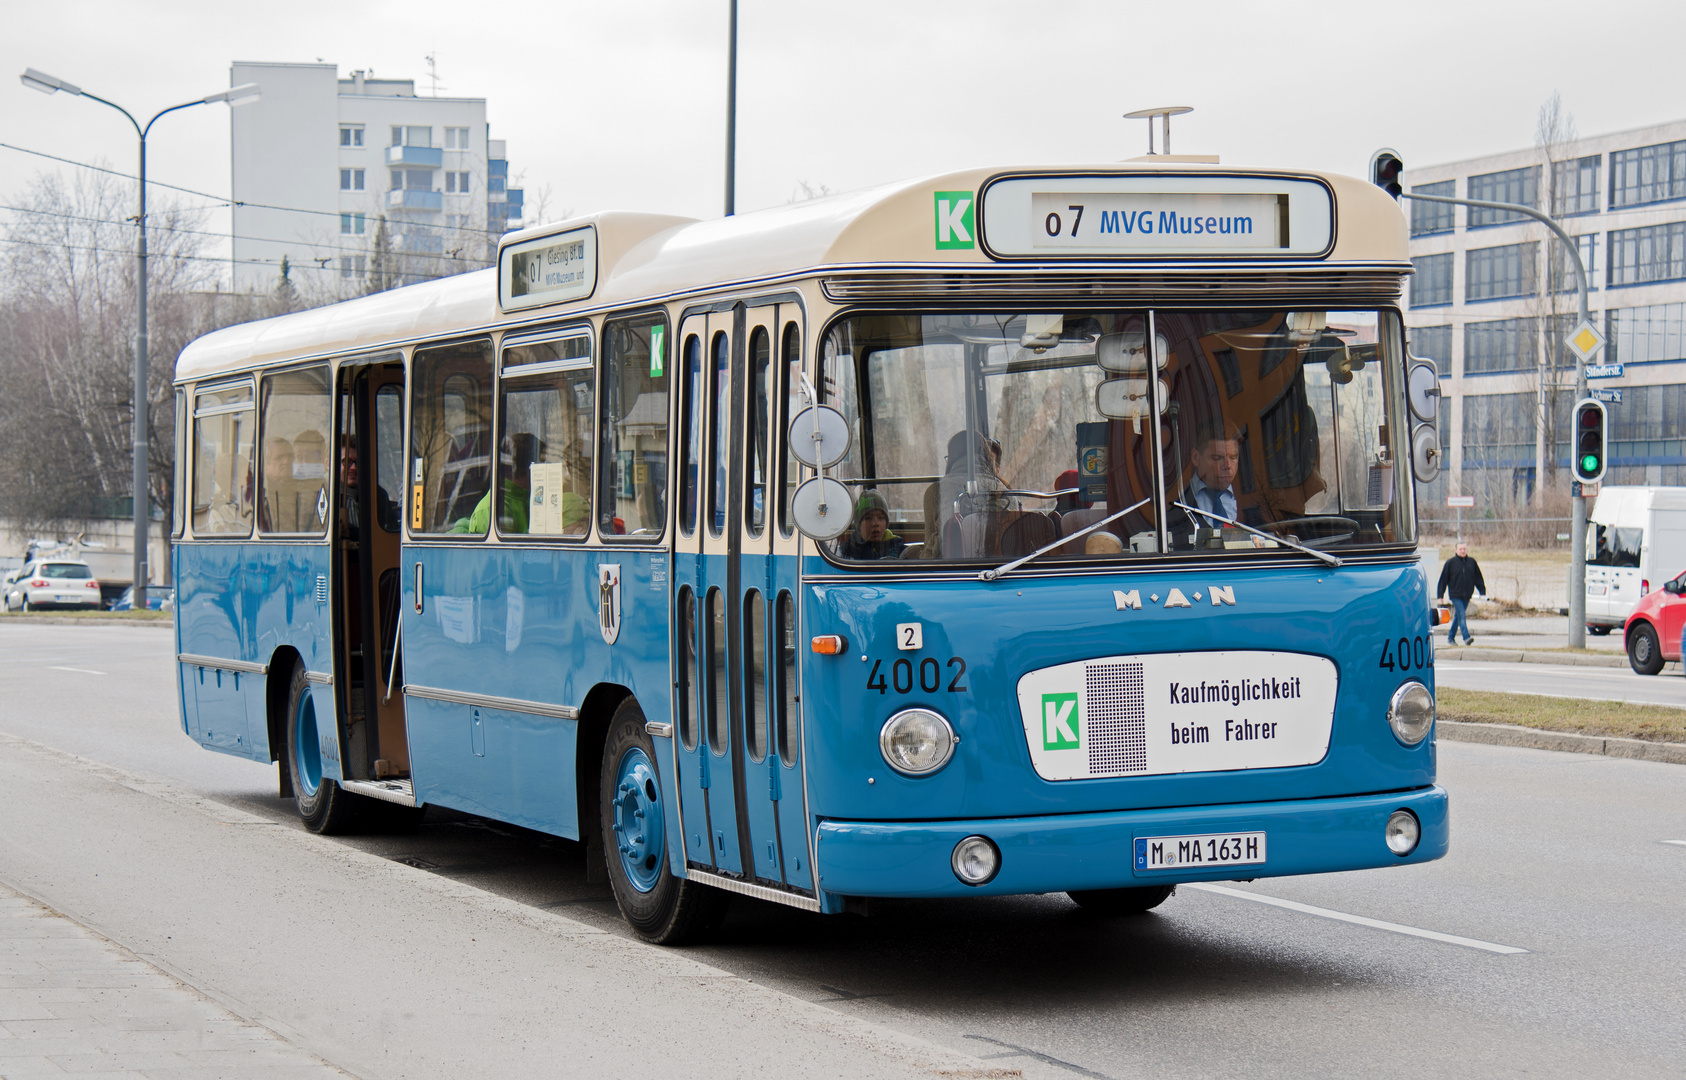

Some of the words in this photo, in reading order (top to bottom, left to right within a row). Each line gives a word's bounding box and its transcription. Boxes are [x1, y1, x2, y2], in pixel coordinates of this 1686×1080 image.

[938, 199, 972, 242] K
[1100, 211, 1153, 234] MVG
[1158, 211, 1253, 234] Museum
[548, 247, 569, 266] Giesing
[556, 271, 575, 284] Museum
[652, 333, 662, 370] K
[904, 627, 915, 647] 2
[1379, 634, 1433, 673] 4002
[867, 656, 968, 695] 4002
[1170, 677, 1301, 707] Kaufmöglichkeit
[1045, 700, 1078, 744] K
[1171, 721, 1210, 745] beim
[1225, 718, 1278, 742] Fahrer
[321, 735, 340, 762] 4002
[1151, 842, 1163, 865] M
